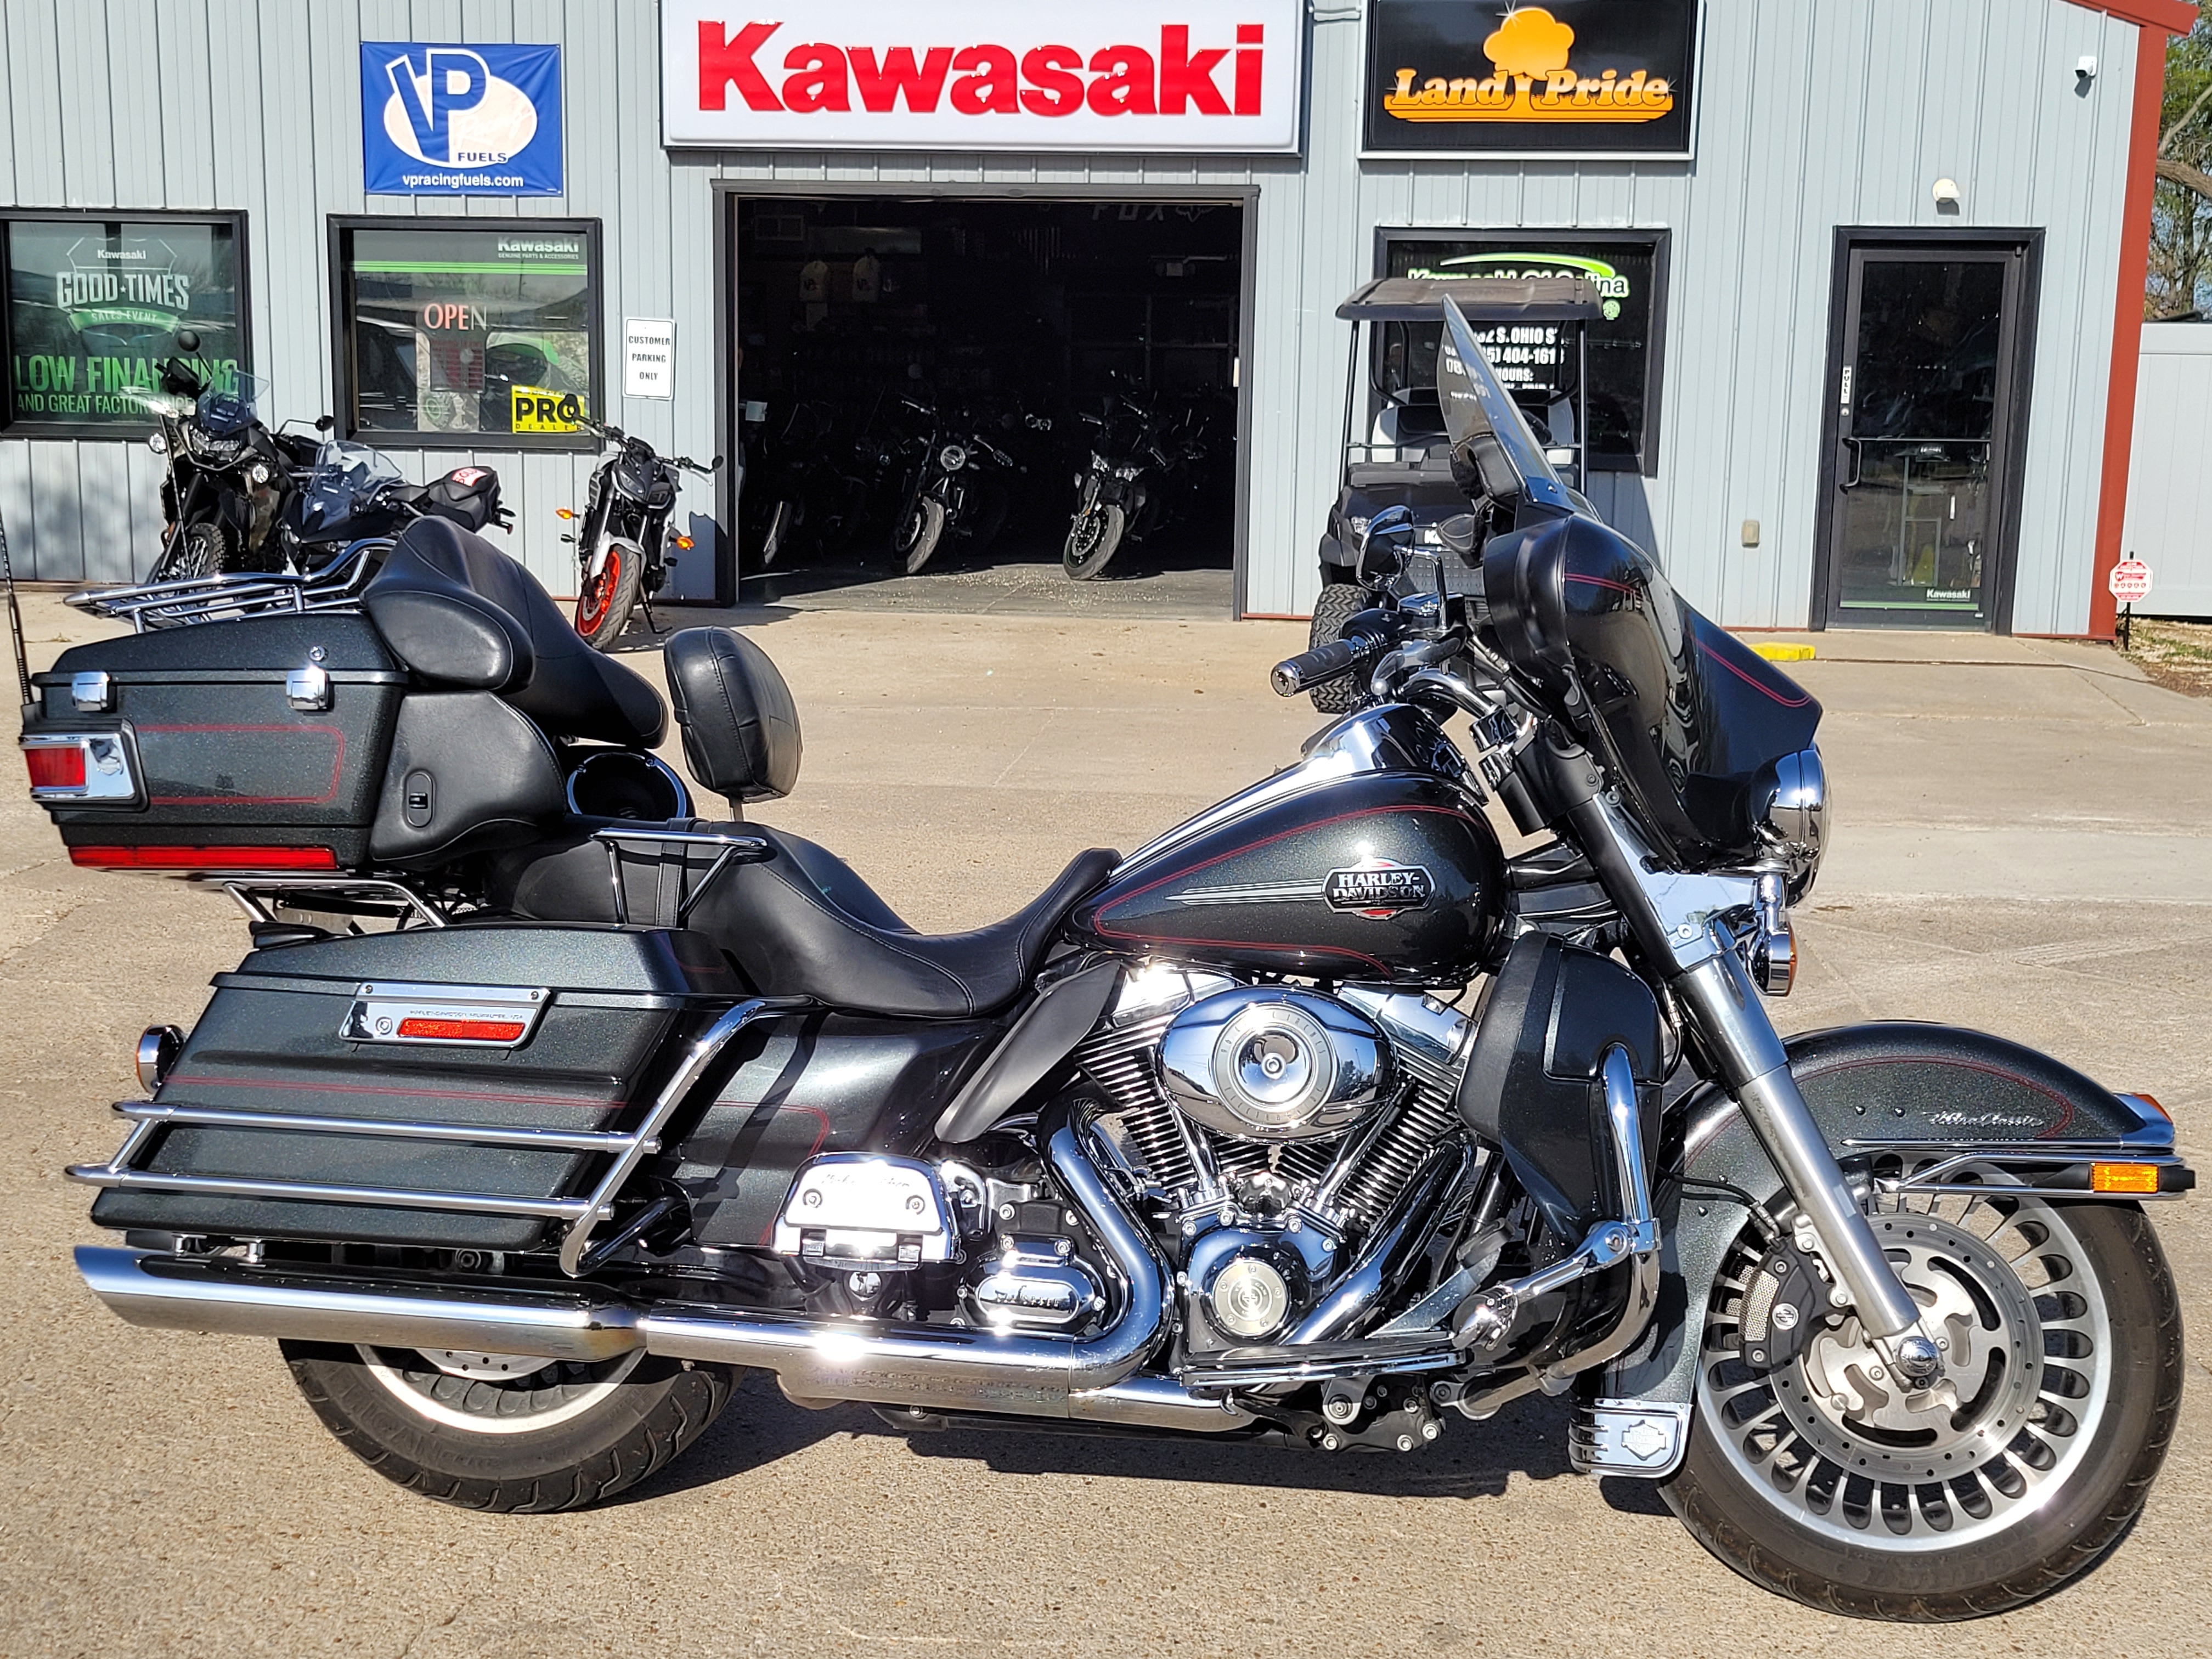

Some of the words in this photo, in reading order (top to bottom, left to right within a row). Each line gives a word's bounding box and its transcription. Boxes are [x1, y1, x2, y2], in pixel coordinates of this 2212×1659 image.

[698, 20, 1264, 116] Kawasaki
[1391, 68, 1510, 106] Land
[1540, 68, 1669, 106] Pride
[385, 48, 490, 163] VP
[458, 152, 507, 163] FUELS
[403, 173, 523, 189] vpracingfuels.com
[498, 236, 579, 252] Kawasaki
[97, 249, 146, 259] Kawasaki
[57, 272, 118, 308] GOOD
[125, 274, 189, 311] TIMES
[126, 310, 158, 323] EVENT
[424, 303, 487, 331] OPEN
[628, 335, 670, 346] CUSTOMER
[1511, 326, 1544, 345] OHIO
[632, 353, 666, 363] PARKING
[15, 355, 75, 392] LOW
[639, 371, 658, 380] ONLY
[18, 393, 44, 411] AND
[48, 394, 91, 413] GREAT
[1926, 588, 1971, 599] Kawasaki
[1338, 872, 1420, 888] HARLEY-
[1333, 884, 1426, 902] DAVIDSON
